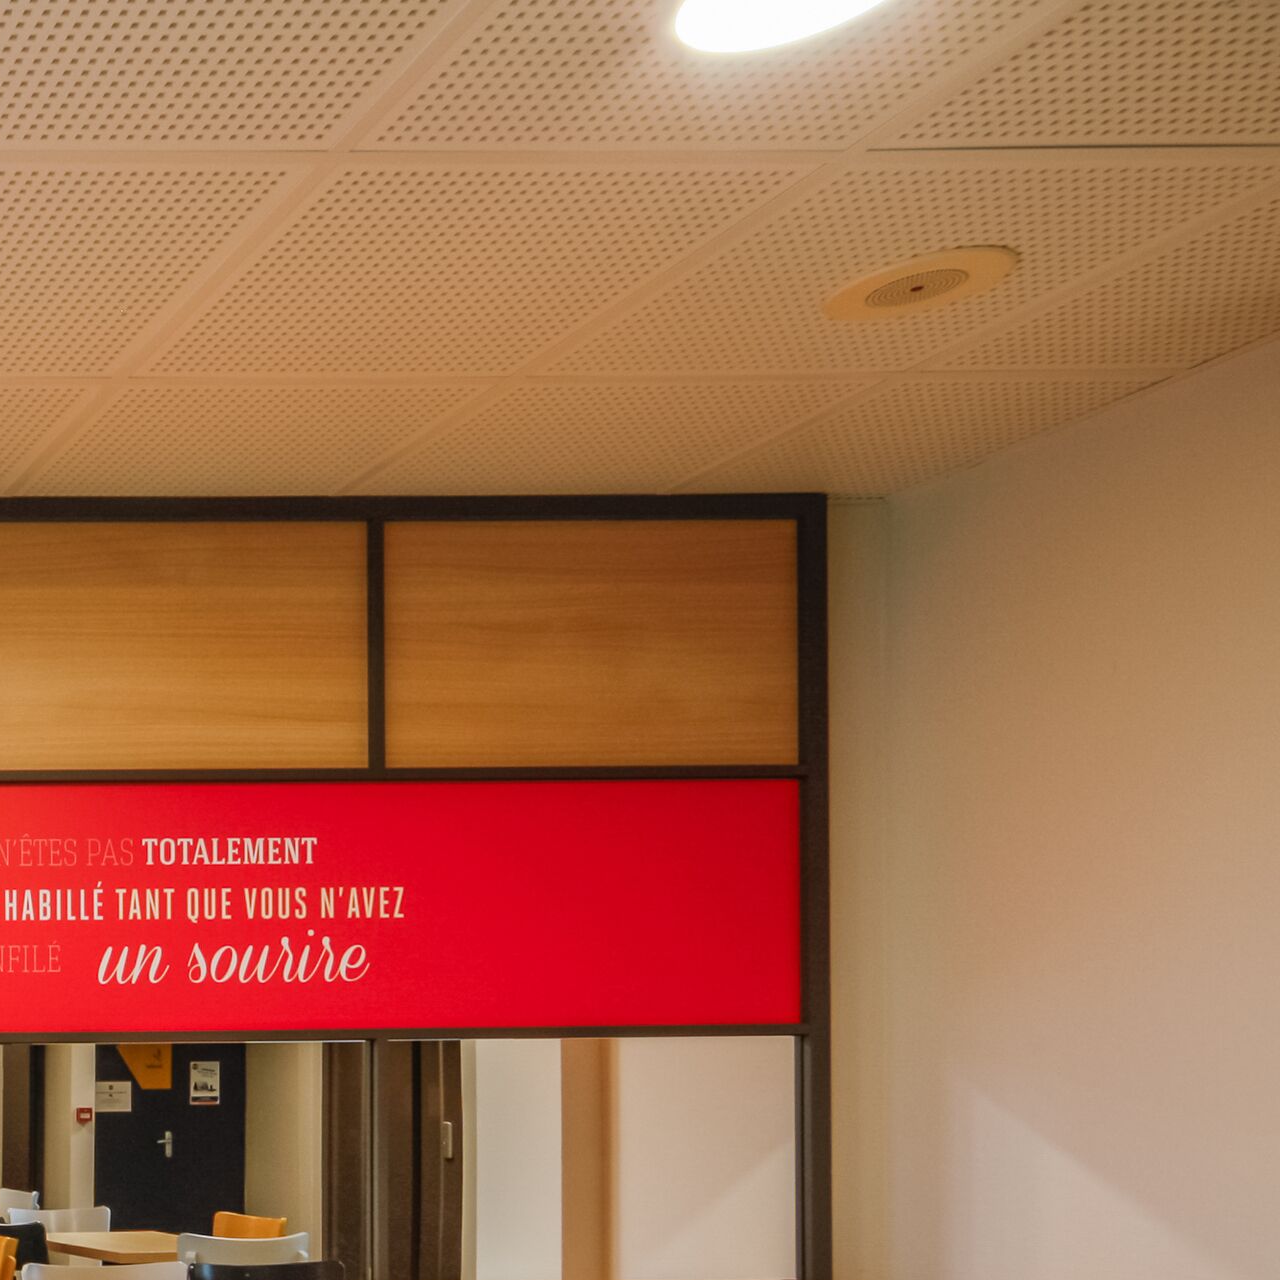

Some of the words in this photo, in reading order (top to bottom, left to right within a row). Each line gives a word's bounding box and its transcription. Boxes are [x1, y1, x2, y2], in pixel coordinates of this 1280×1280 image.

[86, 838, 134, 866] PAS
[141, 837, 318, 866] TOTALEMENT
[4, 881, 104, 921] HABILLÉ
[115, 888, 175, 920] TANT
[186, 887, 232, 923] QUE
[244, 887, 307, 919] VOUS
[320, 886, 405, 919] N'AVEZ
[97, 943, 169, 984] un
[187, 929, 370, 983] sourire
